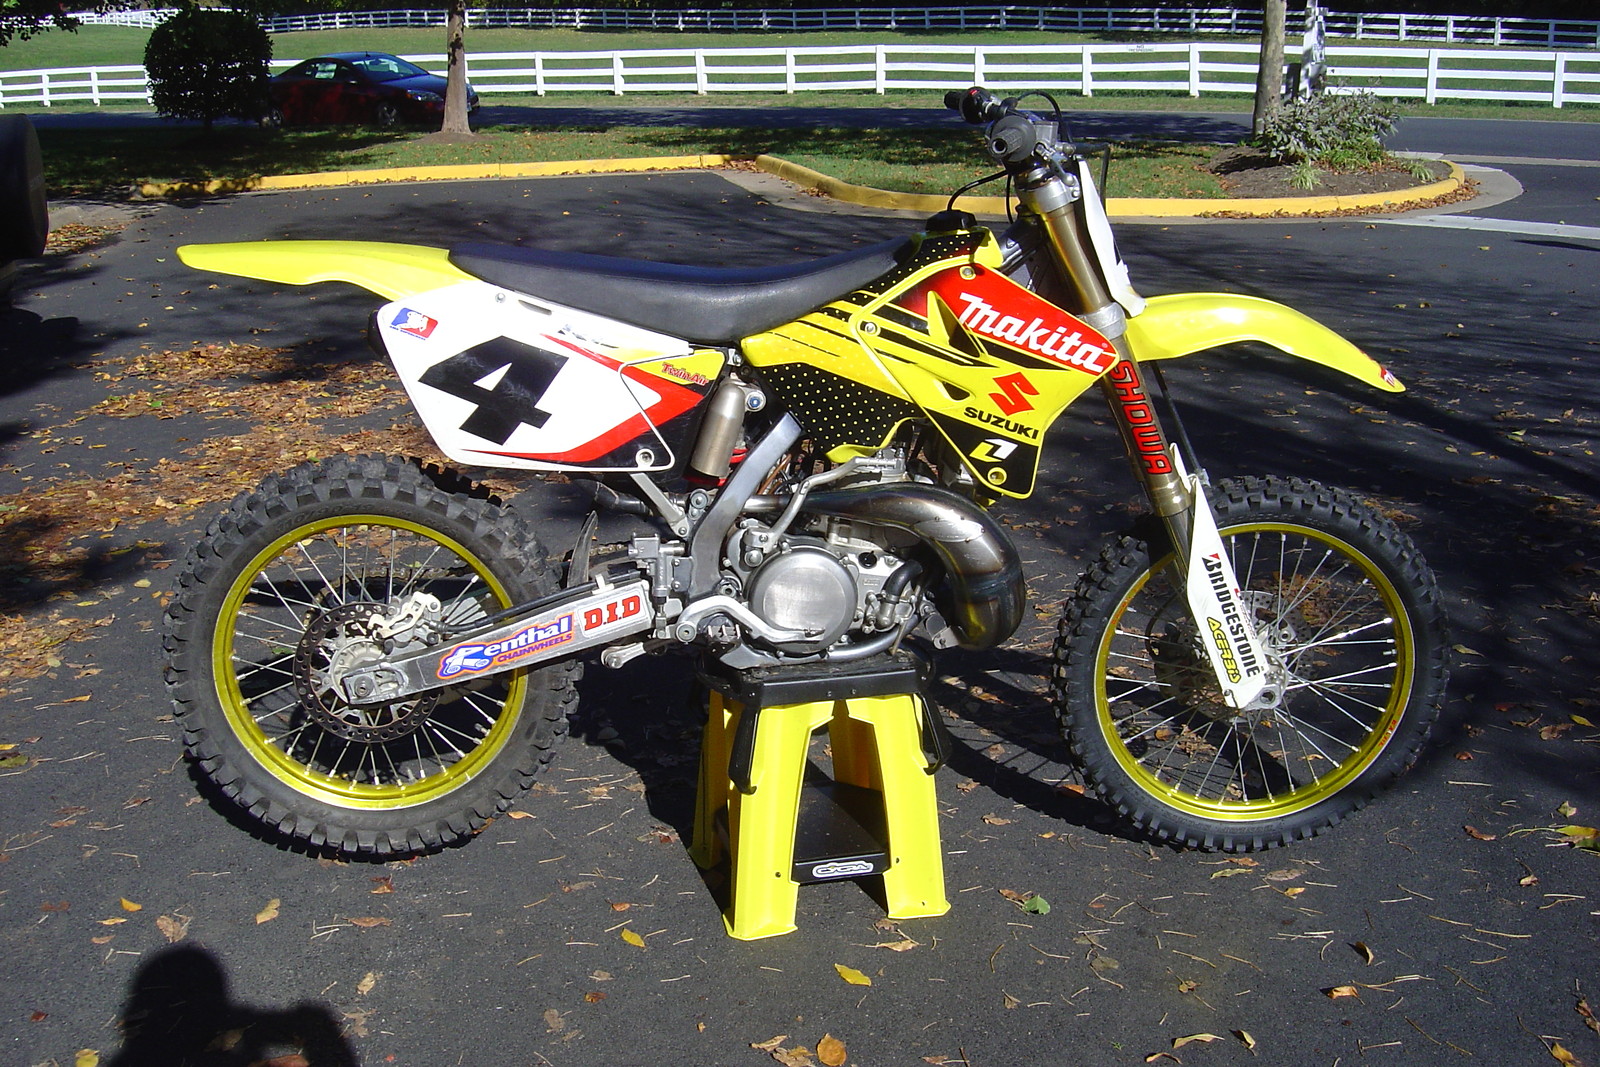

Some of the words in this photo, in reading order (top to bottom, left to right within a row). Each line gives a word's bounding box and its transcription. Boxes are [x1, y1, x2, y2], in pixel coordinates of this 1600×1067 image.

[418, 335, 569, 446] 4
[963, 406, 1039, 440] SUZUKI
[1112, 361, 1173, 475] SHOWA
[444, 614, 573, 676] Renthal
[497, 632, 573, 664] CHAINWHEELS
[1202, 553, 1261, 678] BRIDGESTONE
